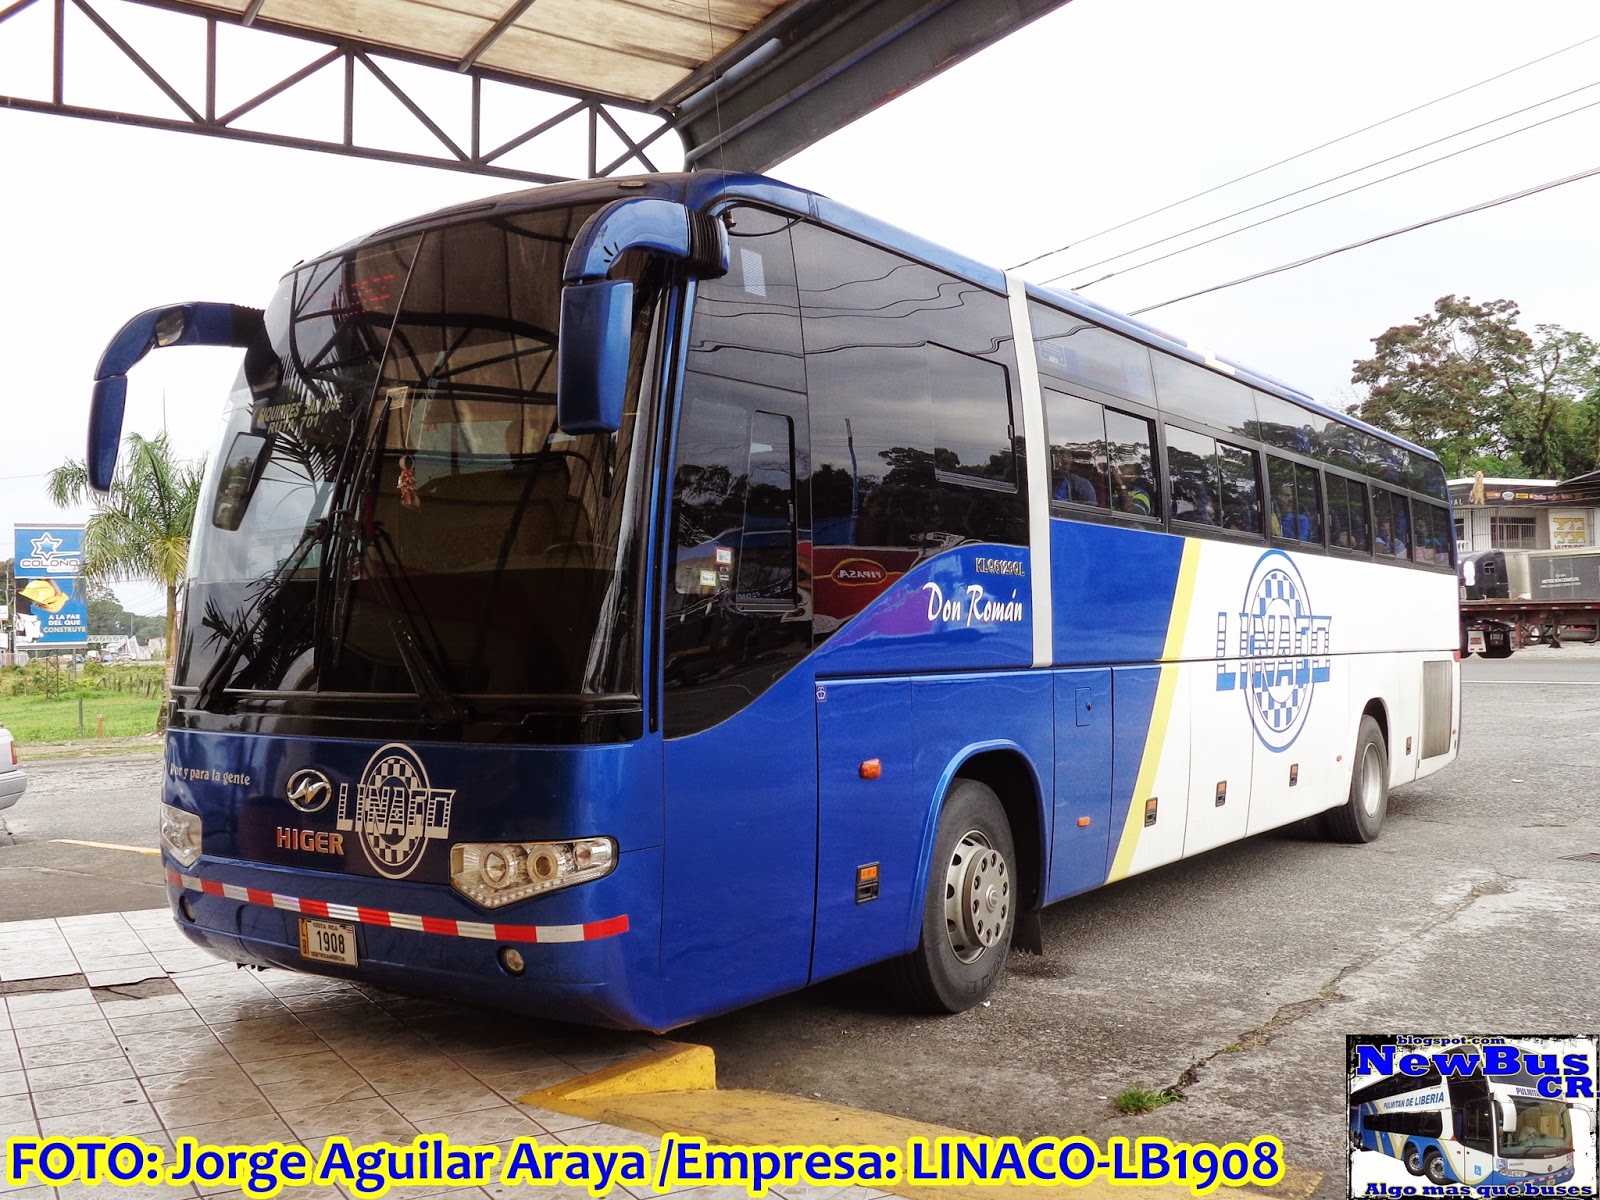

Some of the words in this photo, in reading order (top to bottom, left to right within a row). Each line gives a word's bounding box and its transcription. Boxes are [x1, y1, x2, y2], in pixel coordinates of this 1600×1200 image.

[267, 419, 296, 434] RUTA
[300, 415, 320, 431] 701
[21, 559, 79, 567] COLONO
[923, 582, 961, 622] Don
[966, 584, 1023, 627] Román
[1216, 611, 1332, 692] LINACO
[183, 767, 190, 780] y
[190, 768, 210, 780] para
[211, 768, 221, 782] la
[223, 771, 251, 786] gente
[336, 782, 457, 840] LINACO
[276, 826, 345, 856] HIGER
[316, 930, 345, 955] 1908
